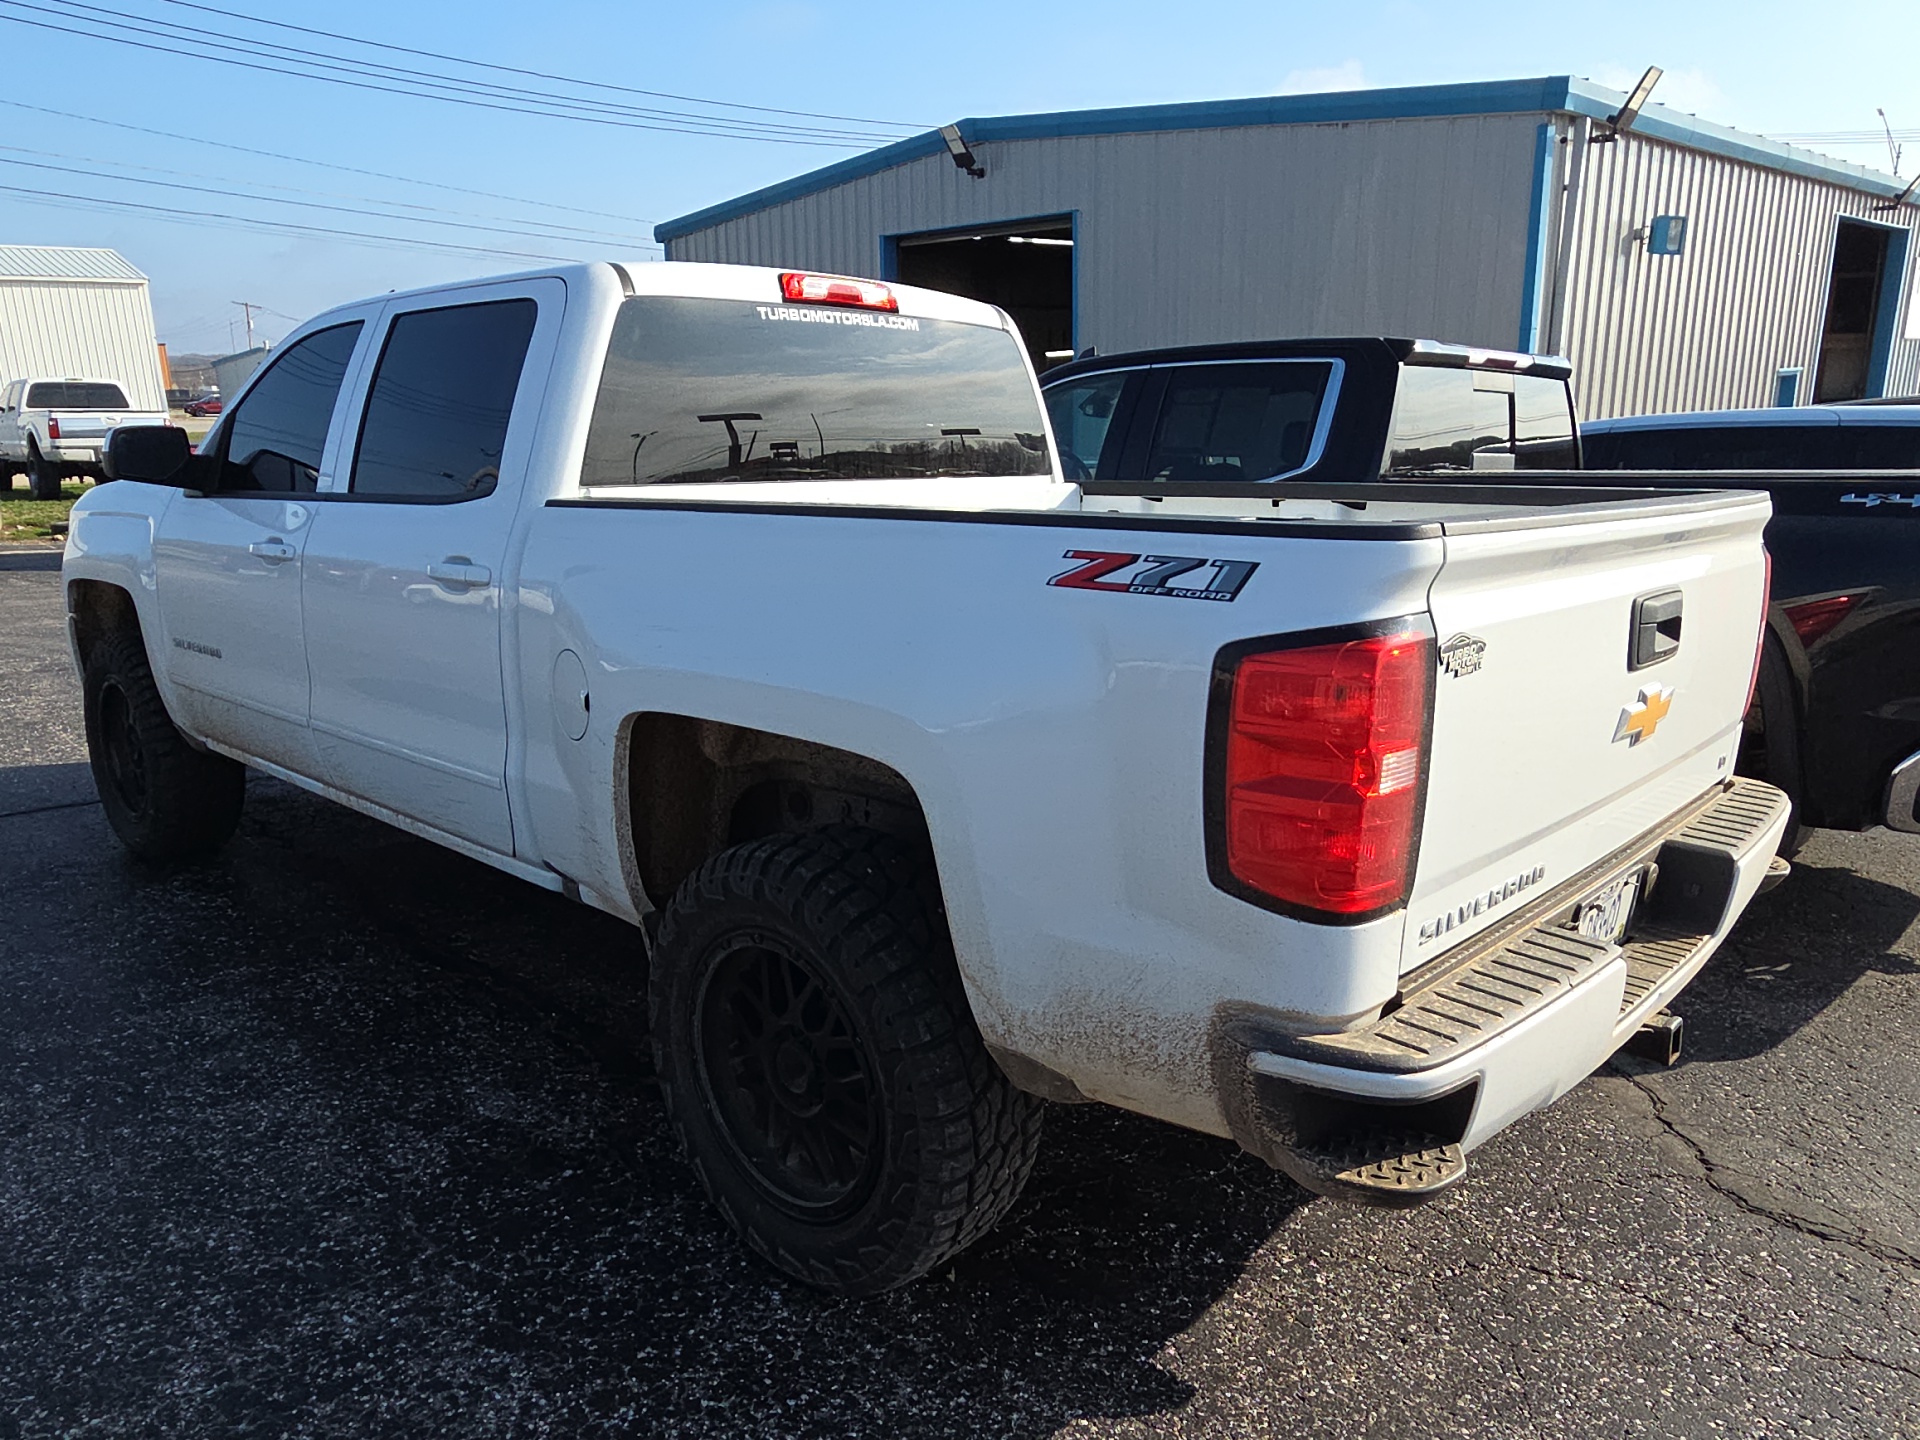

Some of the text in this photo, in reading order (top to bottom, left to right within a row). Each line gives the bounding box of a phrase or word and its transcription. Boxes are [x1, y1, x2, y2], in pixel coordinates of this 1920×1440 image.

[756, 306, 920, 332] TURBOMOTORSLA.COM
[1046, 549, 1261, 600] Z71
[1129, 585, 1232, 601] OFF ROAD
[1418, 862, 1546, 947] SILVERADO
